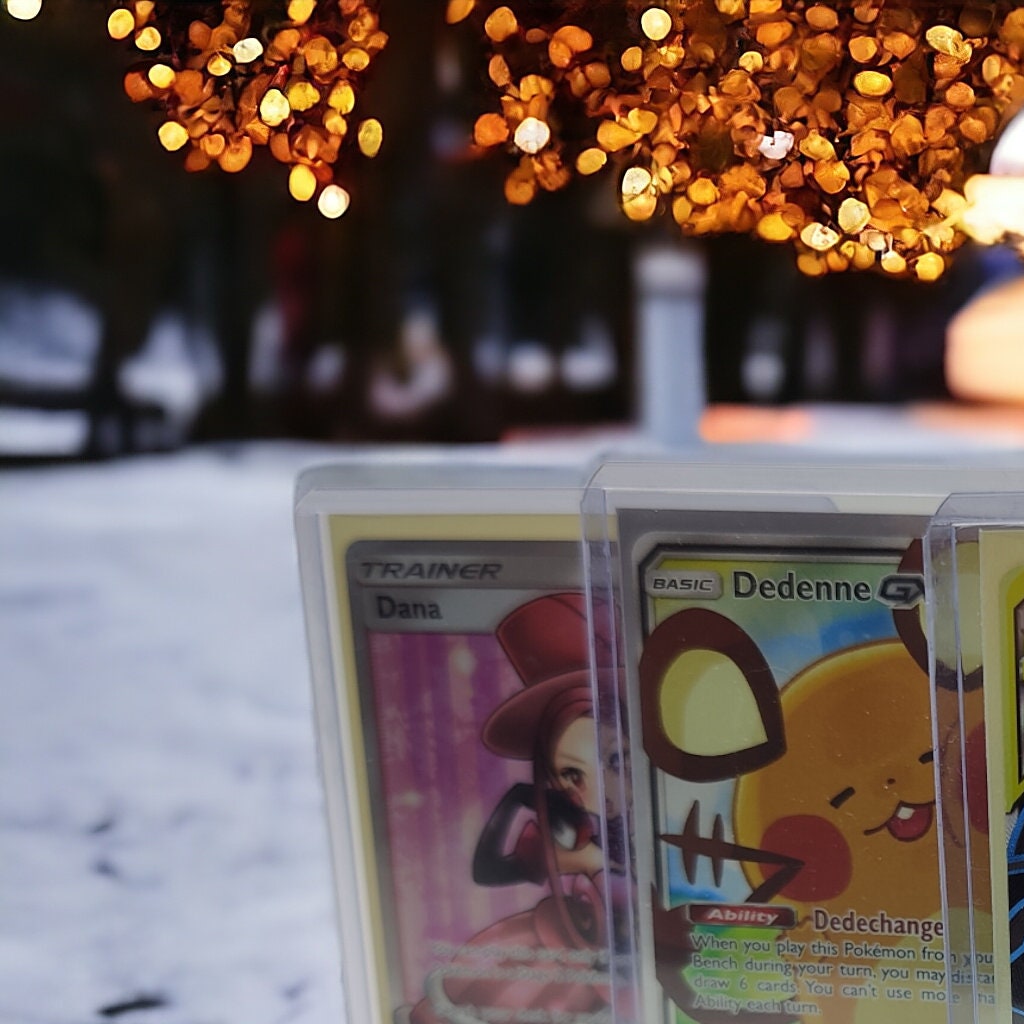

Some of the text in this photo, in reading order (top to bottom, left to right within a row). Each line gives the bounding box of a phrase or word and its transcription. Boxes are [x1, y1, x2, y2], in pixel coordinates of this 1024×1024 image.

[361, 561, 502, 581] TRAINER
[653, 570, 872, 601] BASIC Dedenne
[376, 595, 442, 620] Dana
[707, 908, 945, 942] Ability Dedechange
[690, 934, 916, 960] When you play this Pokémon
[692, 955, 946, 985] Bench during your turn, you may
[694, 975, 912, 1000] draw 6 You can't use
[694, 995, 823, 1015] Ability each turn.
